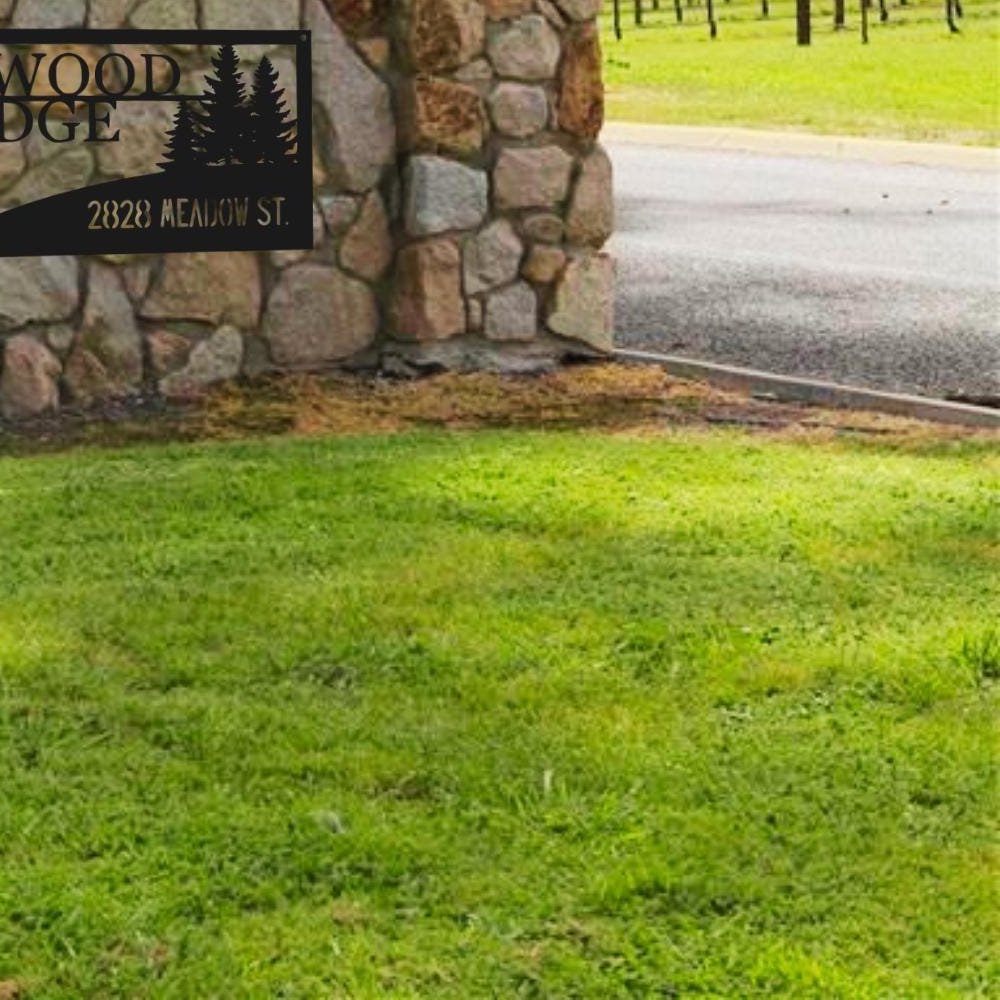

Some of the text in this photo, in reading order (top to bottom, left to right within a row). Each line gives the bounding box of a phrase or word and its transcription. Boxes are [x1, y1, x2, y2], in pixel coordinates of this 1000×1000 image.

[88, 197, 290, 229] 2828 MEADOW ST.
